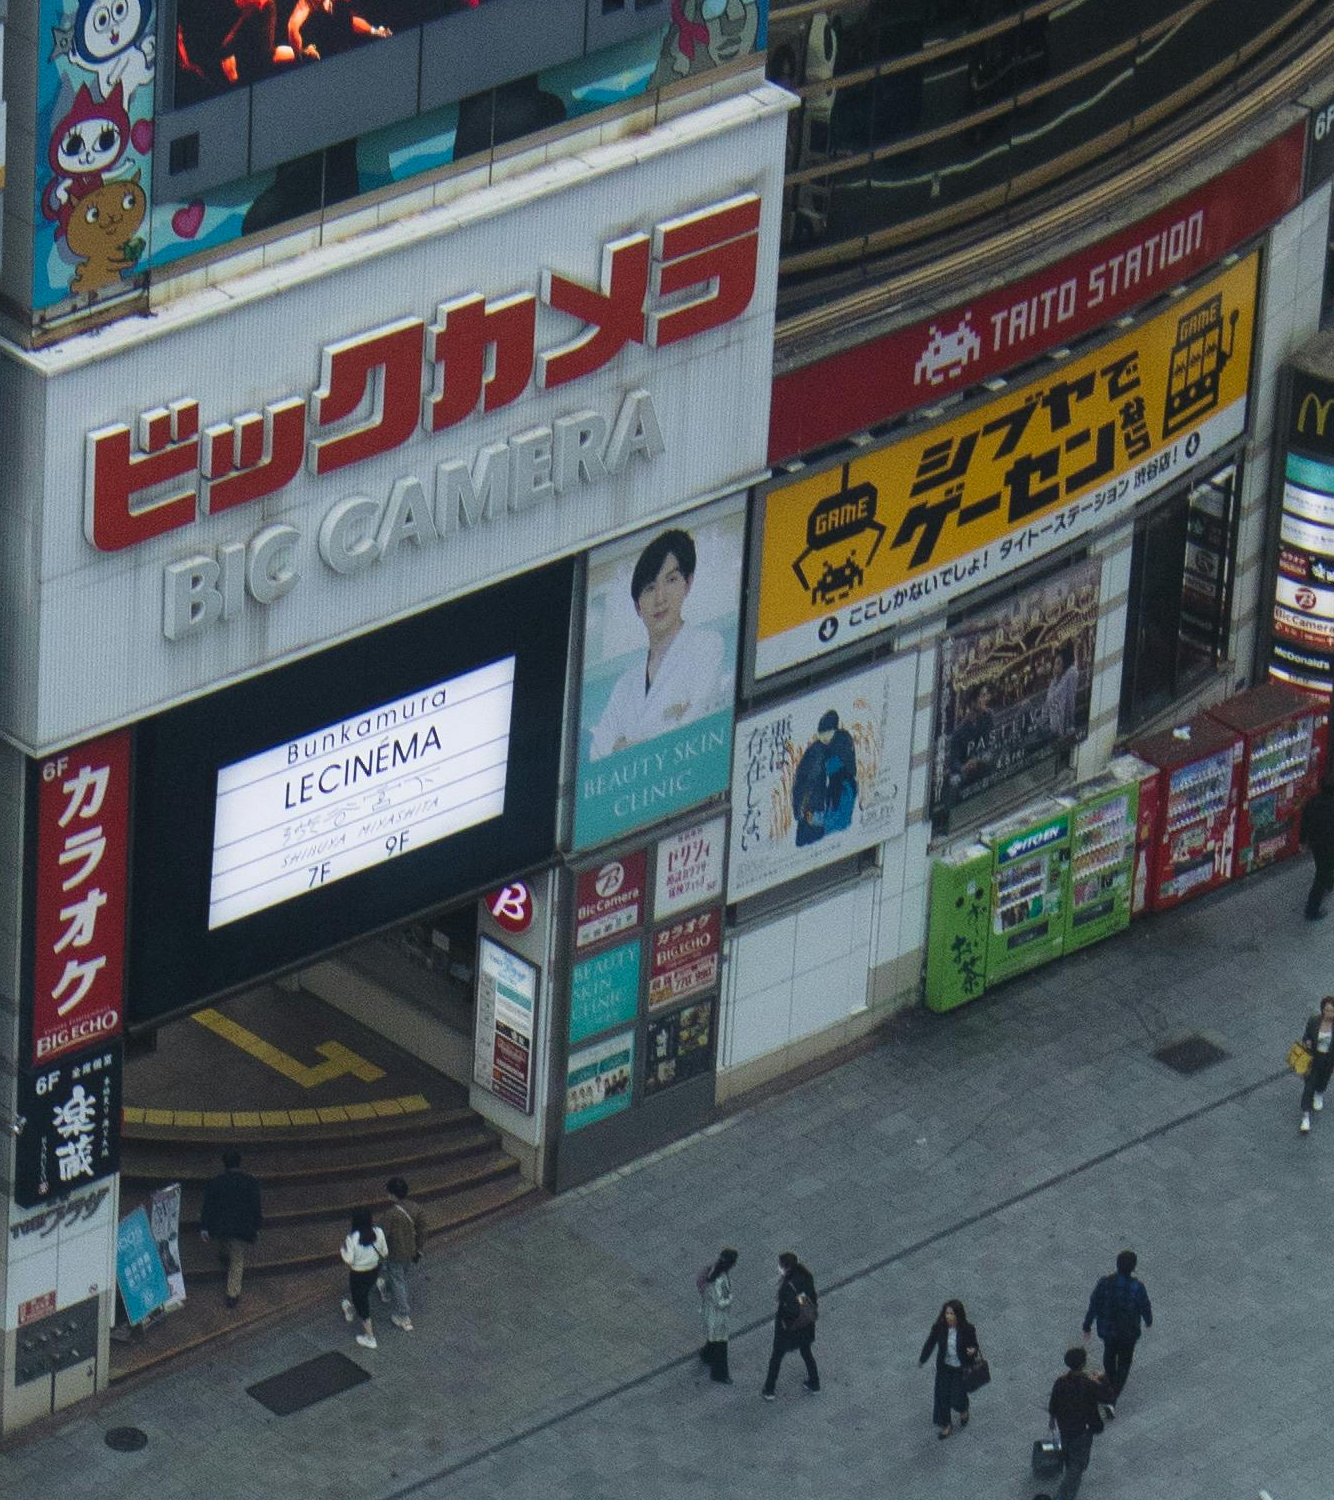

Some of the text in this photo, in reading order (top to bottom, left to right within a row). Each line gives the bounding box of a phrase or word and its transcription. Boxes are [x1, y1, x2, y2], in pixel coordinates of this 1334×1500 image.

[990, 209, 1204, 351] TAITO STATION
[1177, 303, 1222, 342] GAME
[83, 191, 762, 552] ビックカメラ
[910, 349, 1143, 497] シブヤで
[164, 388, 667, 642] BIC CAMERA
[813, 496, 871, 538] GAME
[1000, 476, 1131, 561] タイトーステーション
[1273, 645, 1332, 671] McDonald's
[286, 688, 447, 765] Bunkamura
[42, 752, 69, 781] 6F
[583, 731, 727, 799] BEAUTY SKIN
[613, 768, 693, 818] CLINIC
[384, 830, 411, 857] 9F
[51, 764, 112, 1017] カラオケ
[307, 861, 331, 888] 7F
[577, 888, 642, 923] BicCamera
[656, 911, 712, 947] カラオケ
[572, 945, 637, 983] BEAUTY
[36, 1030, 68, 1059] BIG
[70, 1010, 118, 1040] ECHO
[35, 1070, 61, 1096] 6F
[52, 1083, 96, 1182] 楽蔵
